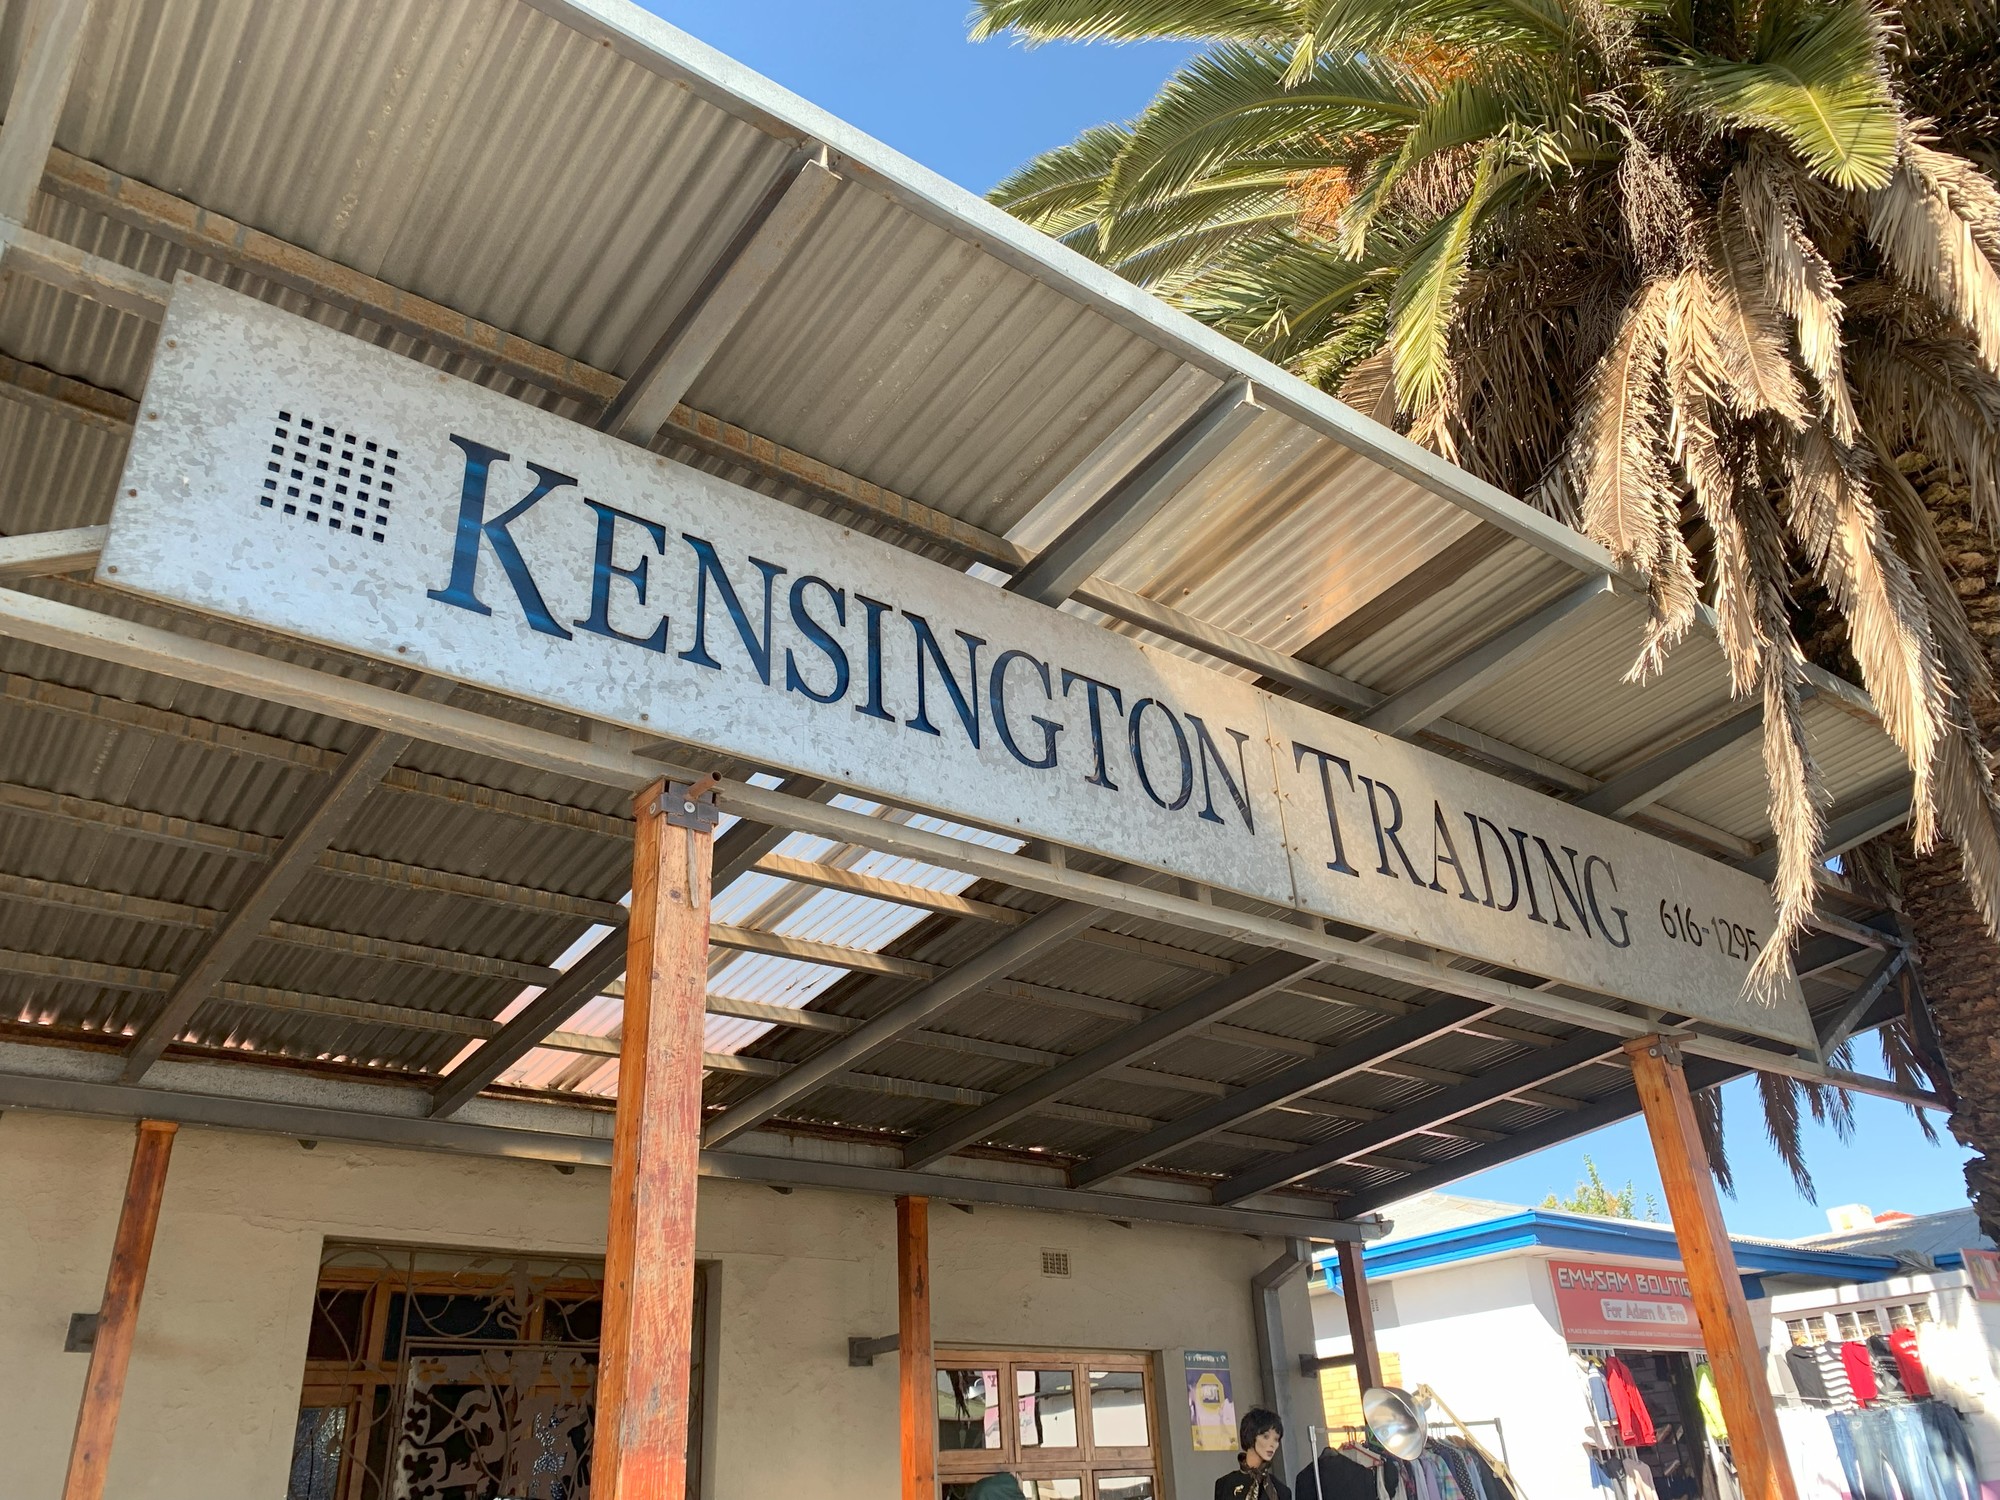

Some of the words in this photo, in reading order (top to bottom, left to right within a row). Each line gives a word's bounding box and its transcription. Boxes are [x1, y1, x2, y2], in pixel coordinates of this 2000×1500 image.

[427, 433, 1255, 836] KENSINGTON
[1292, 741, 1629, 949] TRADING
[1660, 899, 1761, 962] 616-1295
[1557, 1267, 1634, 1293] EMYSAM
[1635, 1273, 1692, 1300] BOUTIQ
[1603, 1301, 1622, 1318] For
[1626, 1302, 1656, 1320] Adam
